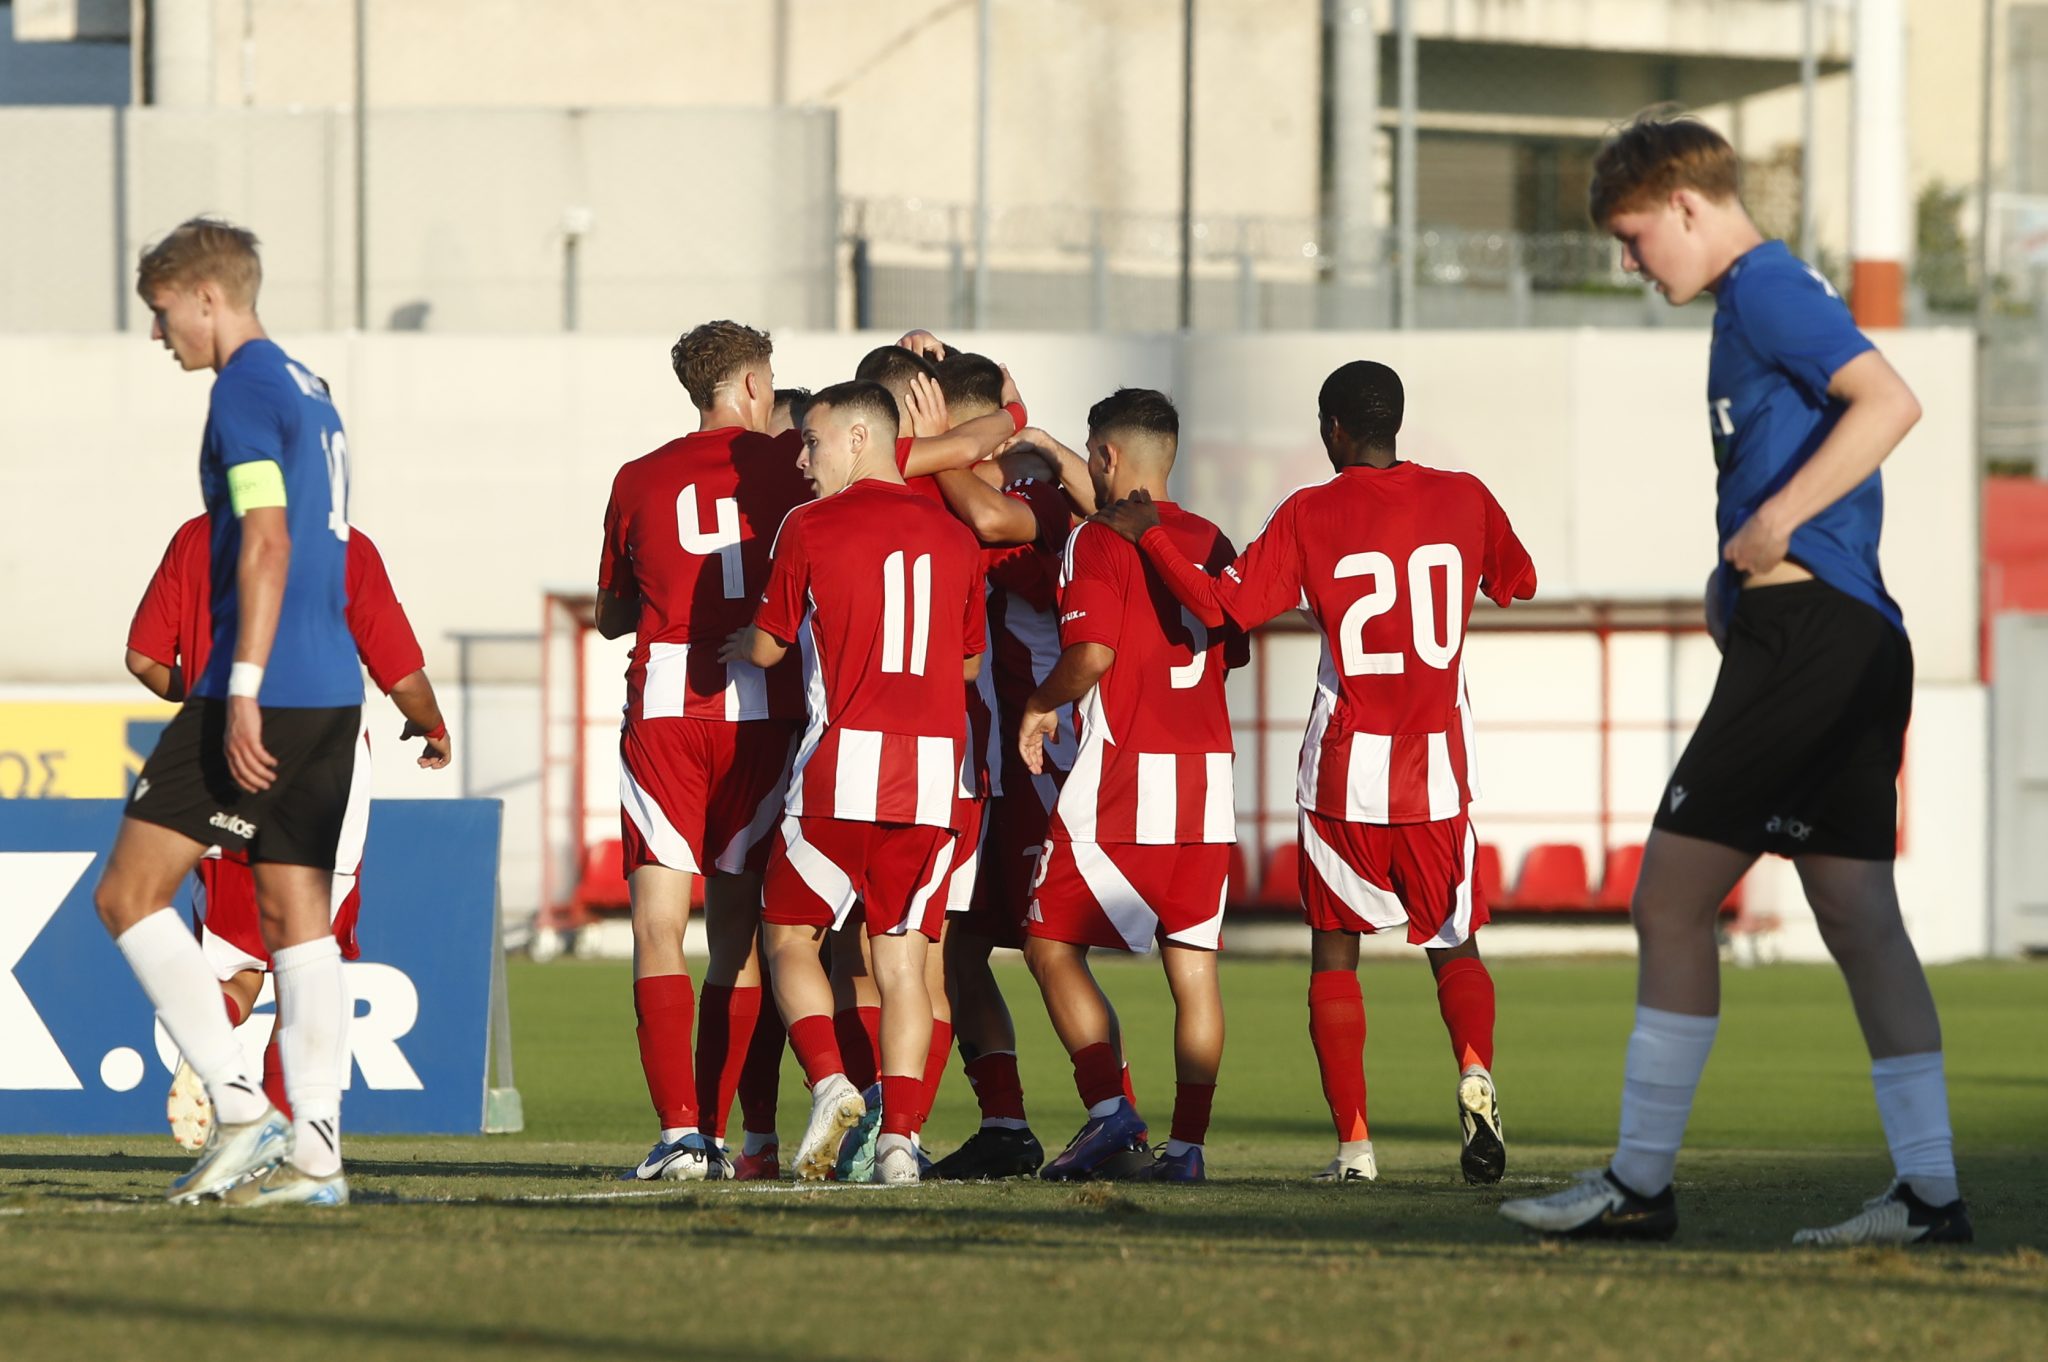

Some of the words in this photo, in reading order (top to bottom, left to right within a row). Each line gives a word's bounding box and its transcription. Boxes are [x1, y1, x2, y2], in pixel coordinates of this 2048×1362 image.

[676, 483, 745, 600] 4
[881, 550, 931, 677] 11
[1333, 543, 1463, 677] 20
